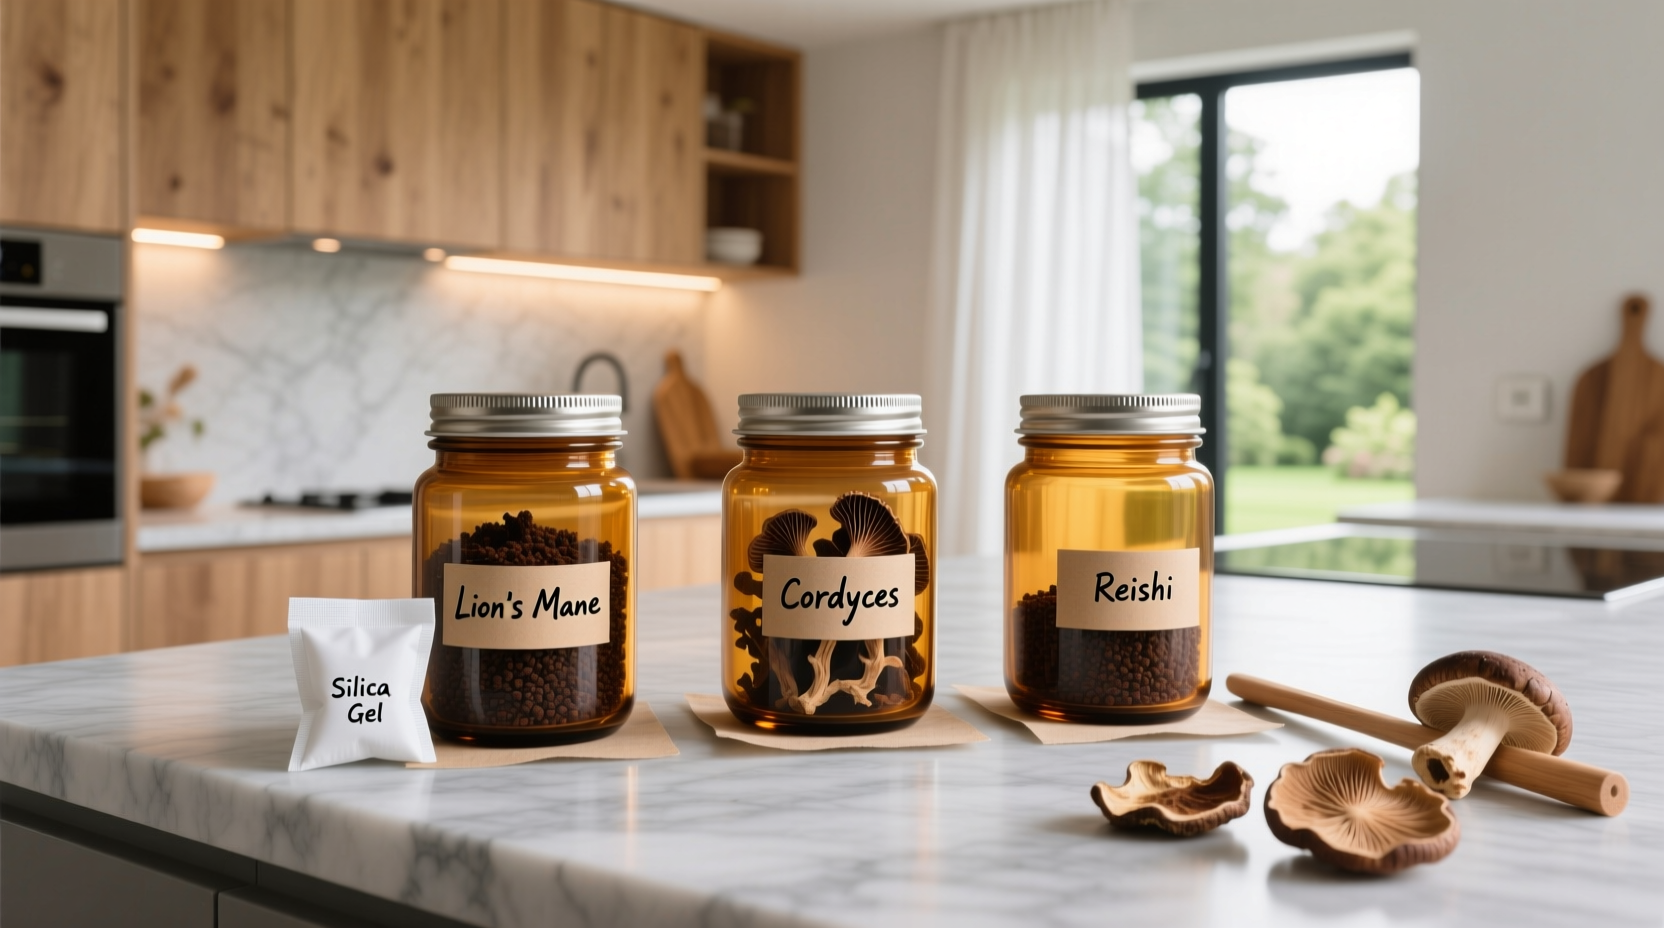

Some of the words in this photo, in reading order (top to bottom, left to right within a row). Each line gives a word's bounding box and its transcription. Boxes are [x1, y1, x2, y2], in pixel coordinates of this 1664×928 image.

[454, 584, 523, 621] Lion's
[532, 586, 601, 620] Mane
[780, 575, 900, 627] Cordyces
[1094, 570, 1174, 603] Reishi
[331, 675, 391, 699] Silica
[347, 702, 383, 725] Gel
